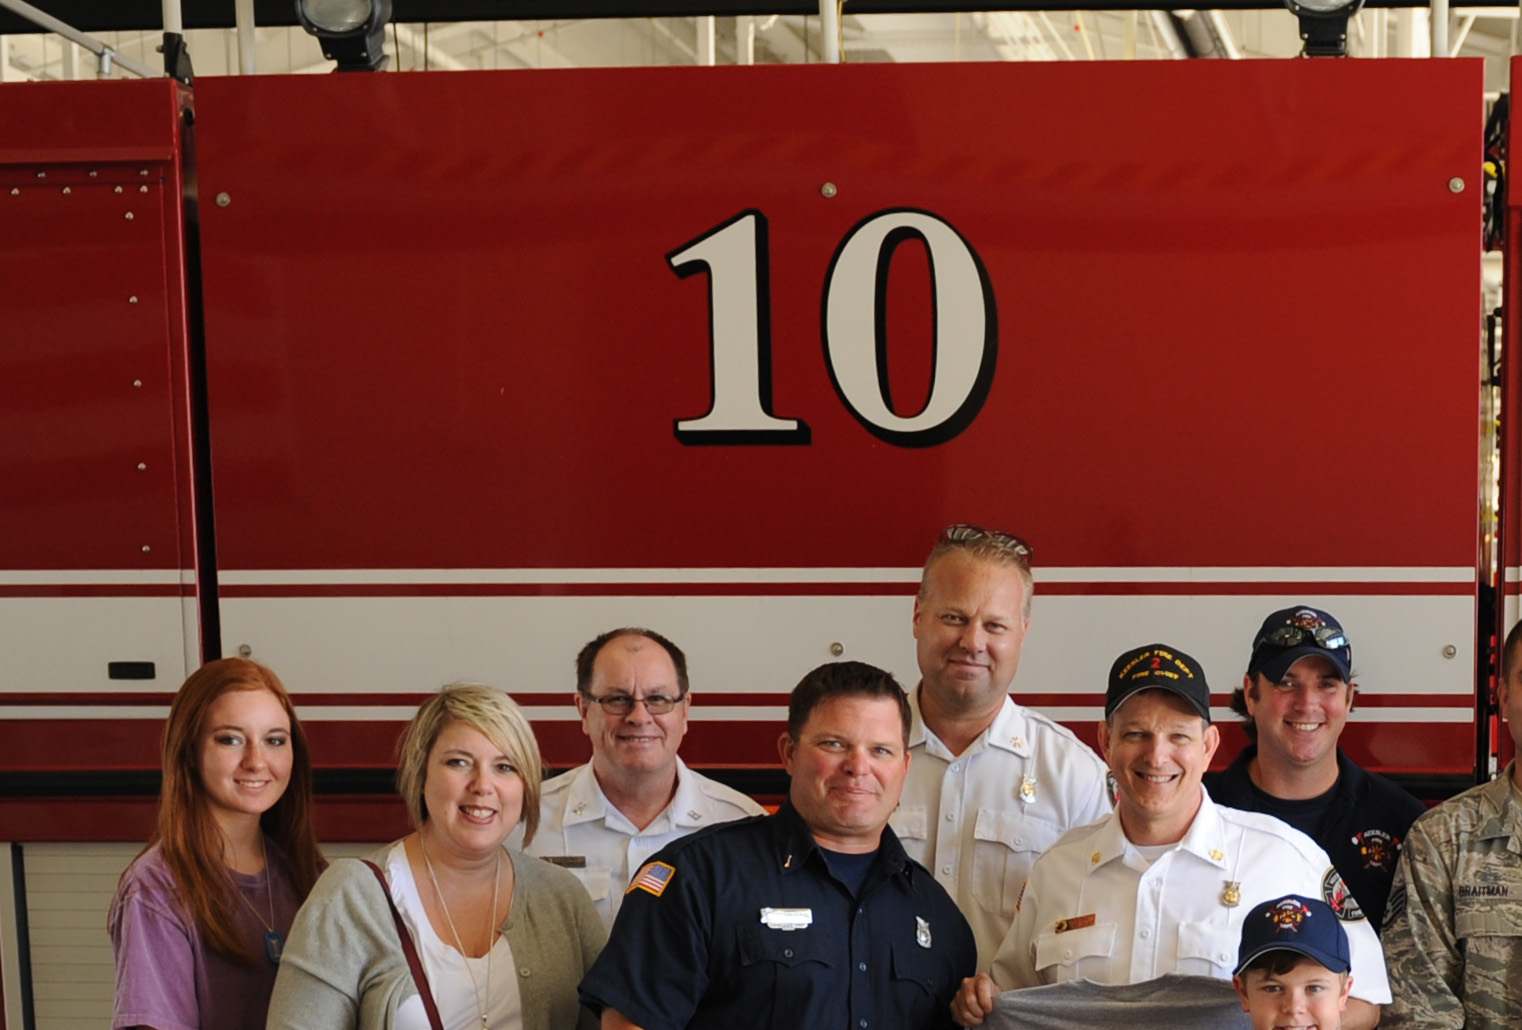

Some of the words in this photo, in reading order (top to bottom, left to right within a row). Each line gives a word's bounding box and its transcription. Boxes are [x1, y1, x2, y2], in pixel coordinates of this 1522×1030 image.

[666, 208, 997, 446] 10
[1154, 649, 1173, 661] FIRE
[1150, 657, 1161, 669] 2
[1458, 885, 1510, 898] BRAITMAN
